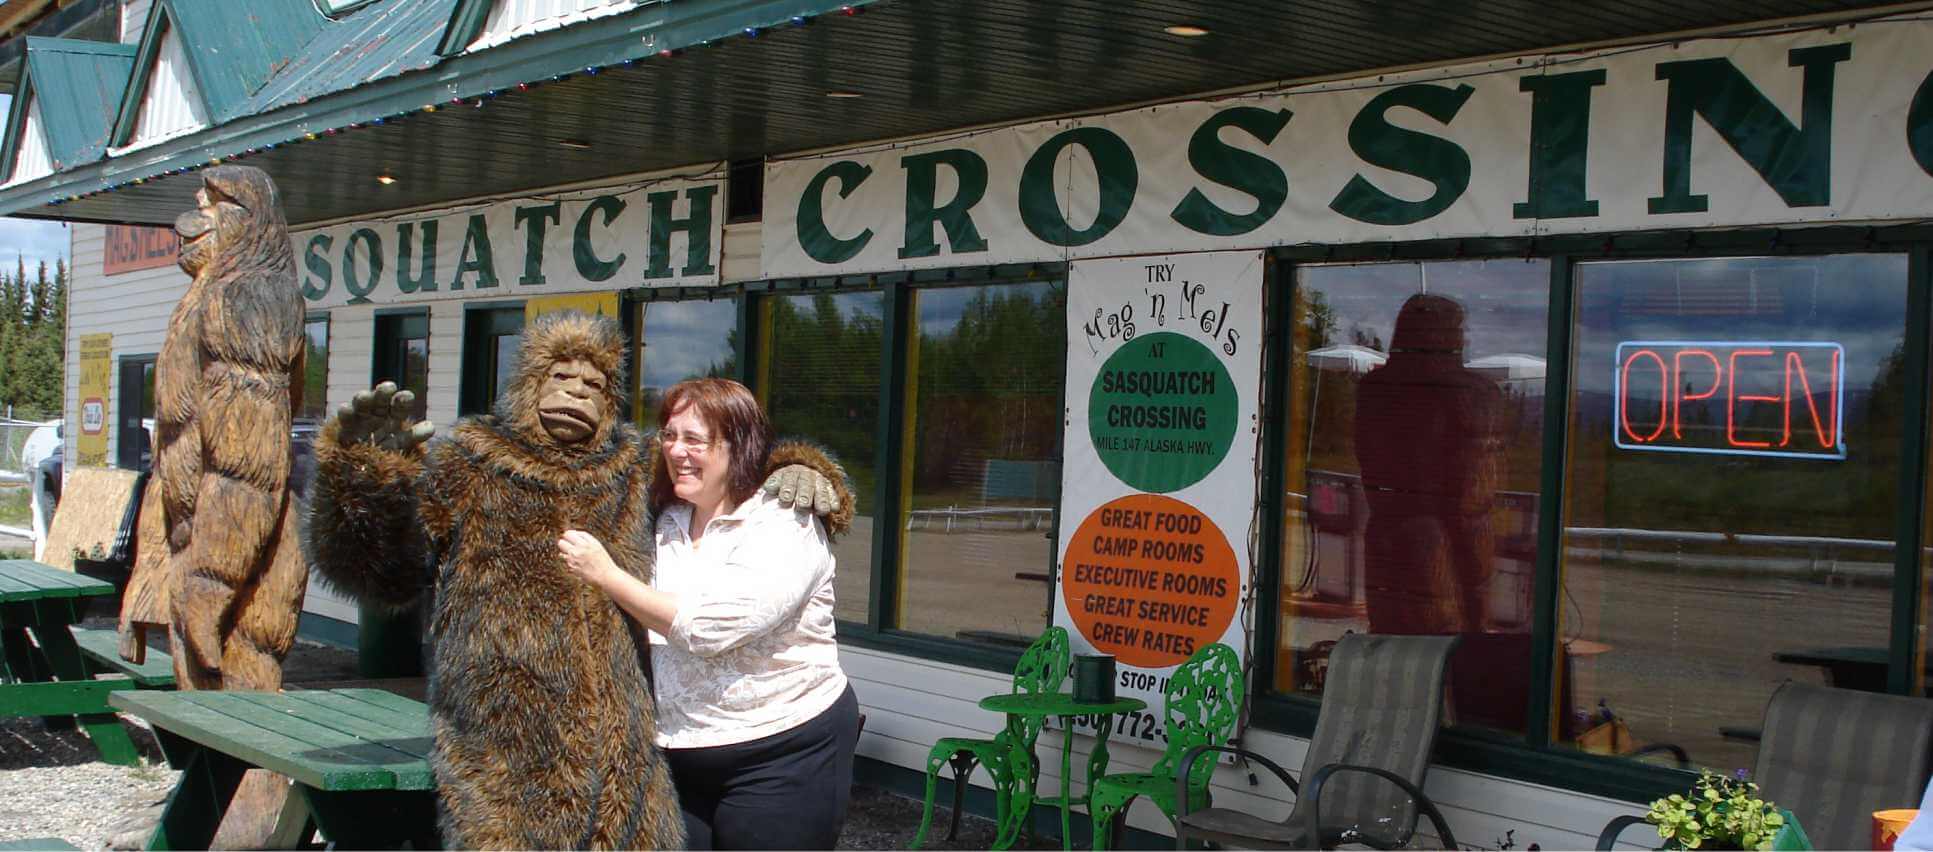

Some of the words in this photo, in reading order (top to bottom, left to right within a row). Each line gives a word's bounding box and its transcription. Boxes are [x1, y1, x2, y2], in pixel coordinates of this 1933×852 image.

[1145, 264, 1175, 282] TRY
[1083, 301, 1136, 358] Mag
[1178, 281, 1240, 356] Mels
[1148, 342, 1166, 358] AT
[1103, 371, 1216, 397] SASQUATCH
[1620, 349, 1841, 449] OPEN
[1107, 405, 1207, 430] CROSSING
[1096, 436, 1119, 450] MILE
[1123, 438, 1140, 451] 147
[1144, 439, 1185, 453] ALASKA
[1187, 440, 1215, 455] HWY.
[1101, 508, 1152, 530] GREAT
[1155, 512, 1201, 534] FOOD
[1093, 535, 1138, 558] CAMP
[1142, 540, 1205, 564] ROOMS
[1074, 564, 1158, 590] EXECUTIVE
[1162, 573, 1227, 598] ROOMS
[1084, 594, 1135, 618] GREAT
[1138, 600, 1210, 627] SERVICE
[1092, 622, 1139, 647] CREW
[1142, 630, 1195, 656] RATES
[1120, 671, 1156, 691] STOP
